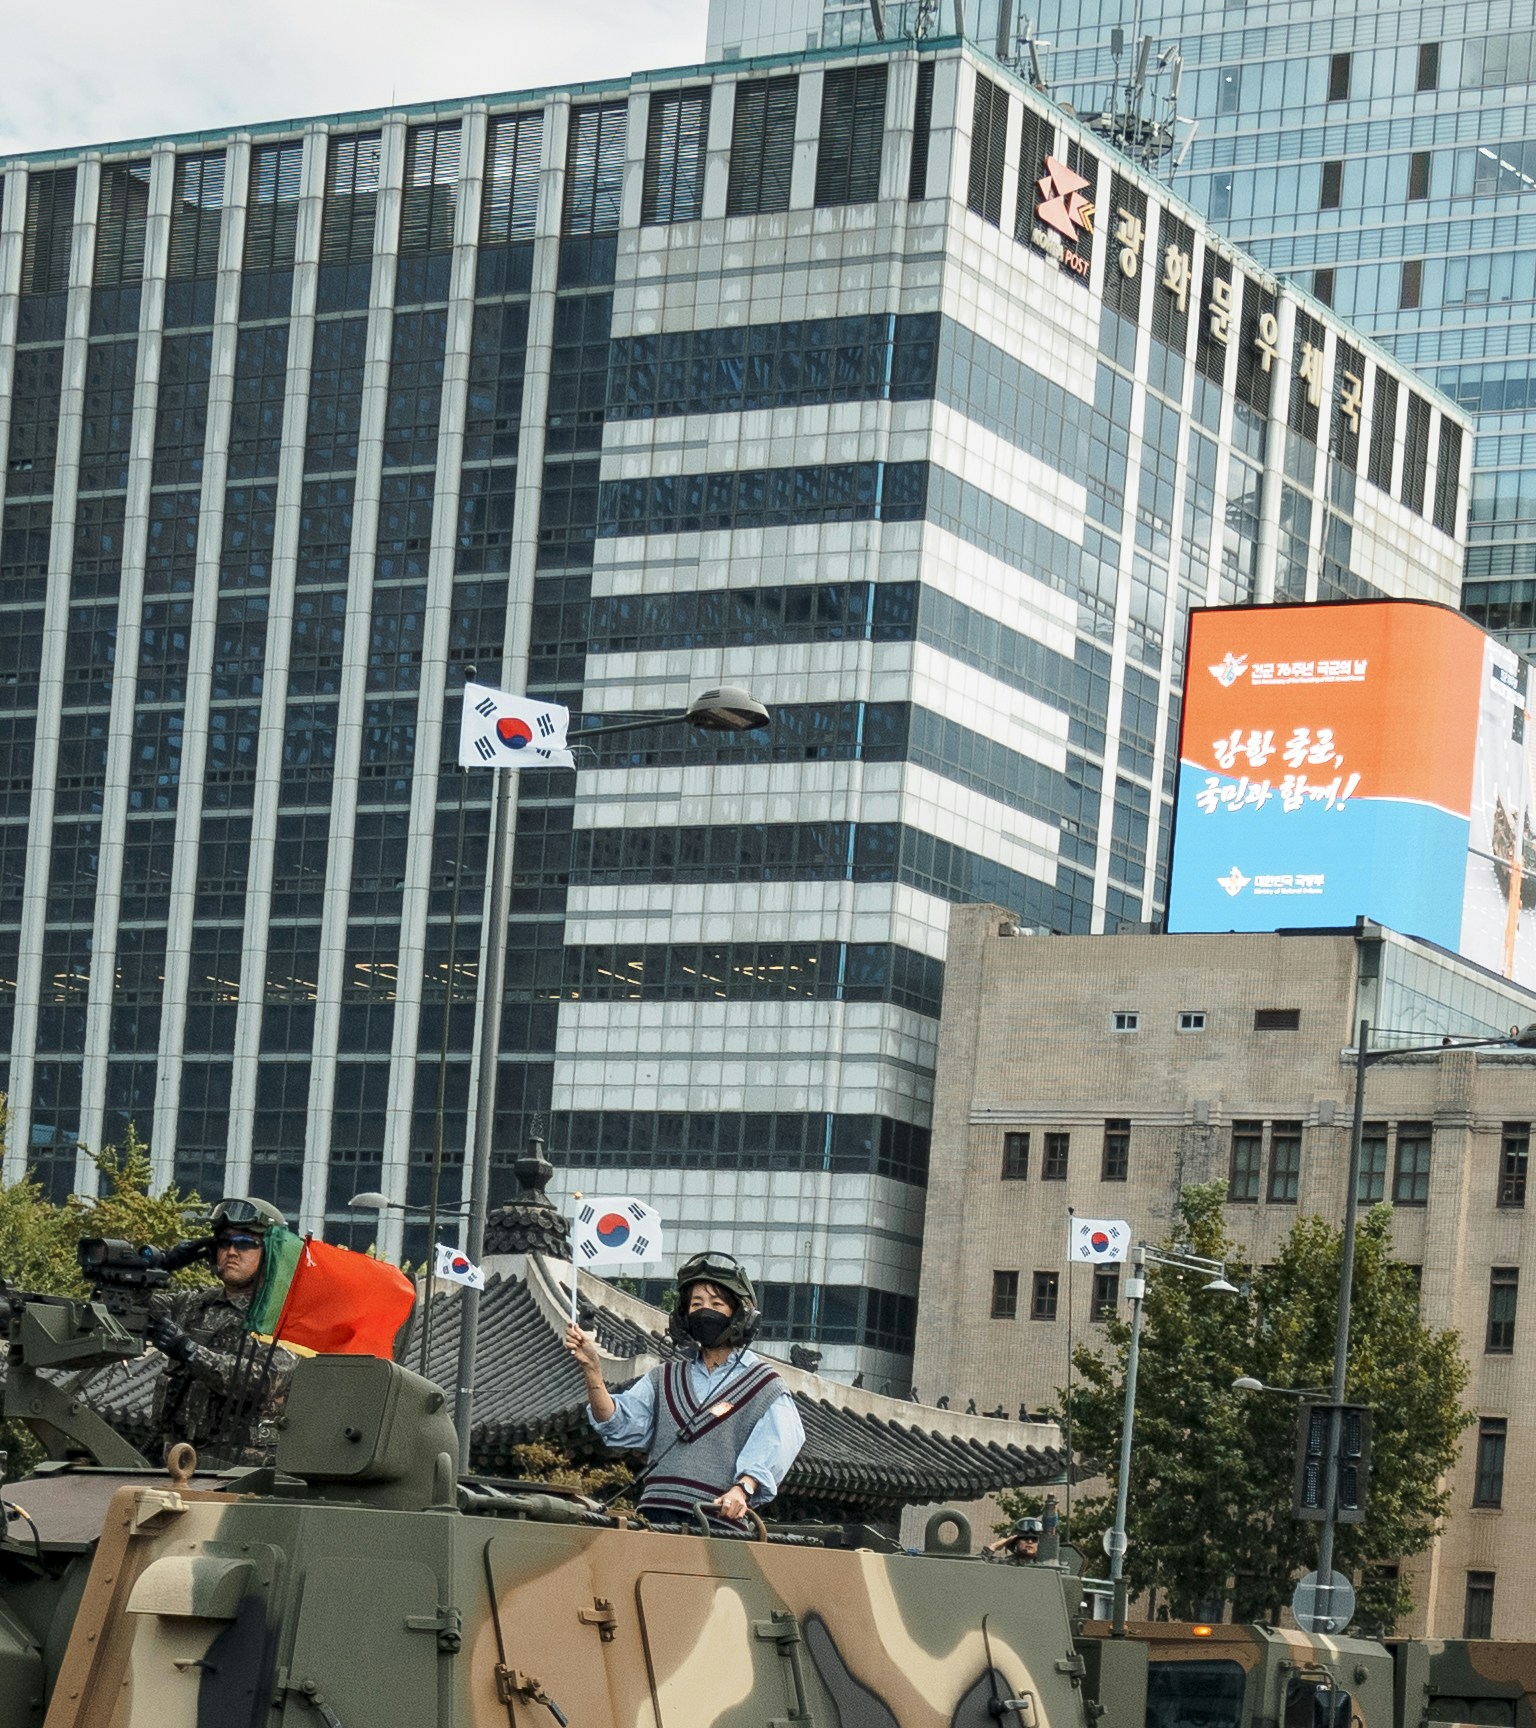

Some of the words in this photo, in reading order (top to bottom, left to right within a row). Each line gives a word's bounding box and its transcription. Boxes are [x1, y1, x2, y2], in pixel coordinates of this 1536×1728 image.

[1065, 249, 1090, 276] POST
[1114, 207, 1363, 434] 광화문우체국
[1212, 729, 1276, 769] 강한
[1195, 776, 1273, 814] 국민과
